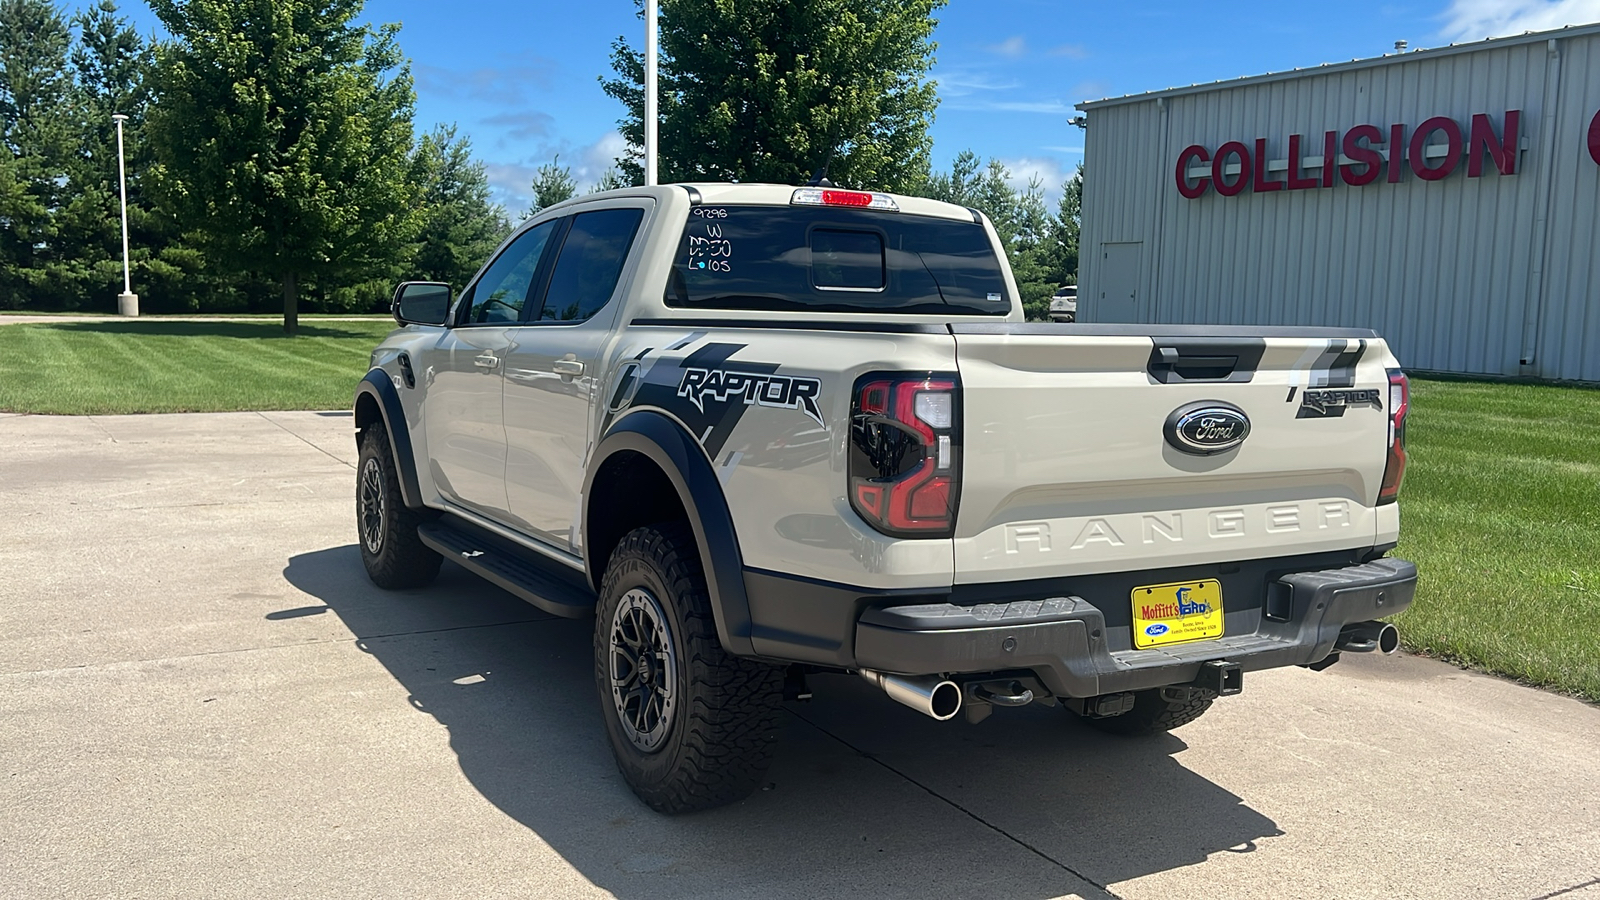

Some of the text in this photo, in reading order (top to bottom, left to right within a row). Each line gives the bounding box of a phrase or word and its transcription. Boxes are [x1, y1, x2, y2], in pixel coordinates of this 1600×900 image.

[1175, 109, 1523, 199] COLLISION
[677, 367, 827, 431] RAPTOR
[1302, 388, 1384, 415] RAPTOR
[1195, 417, 1235, 440] Ford
[1005, 499, 1350, 554] RANGER
[1141, 602, 1179, 620] Moffitt's
